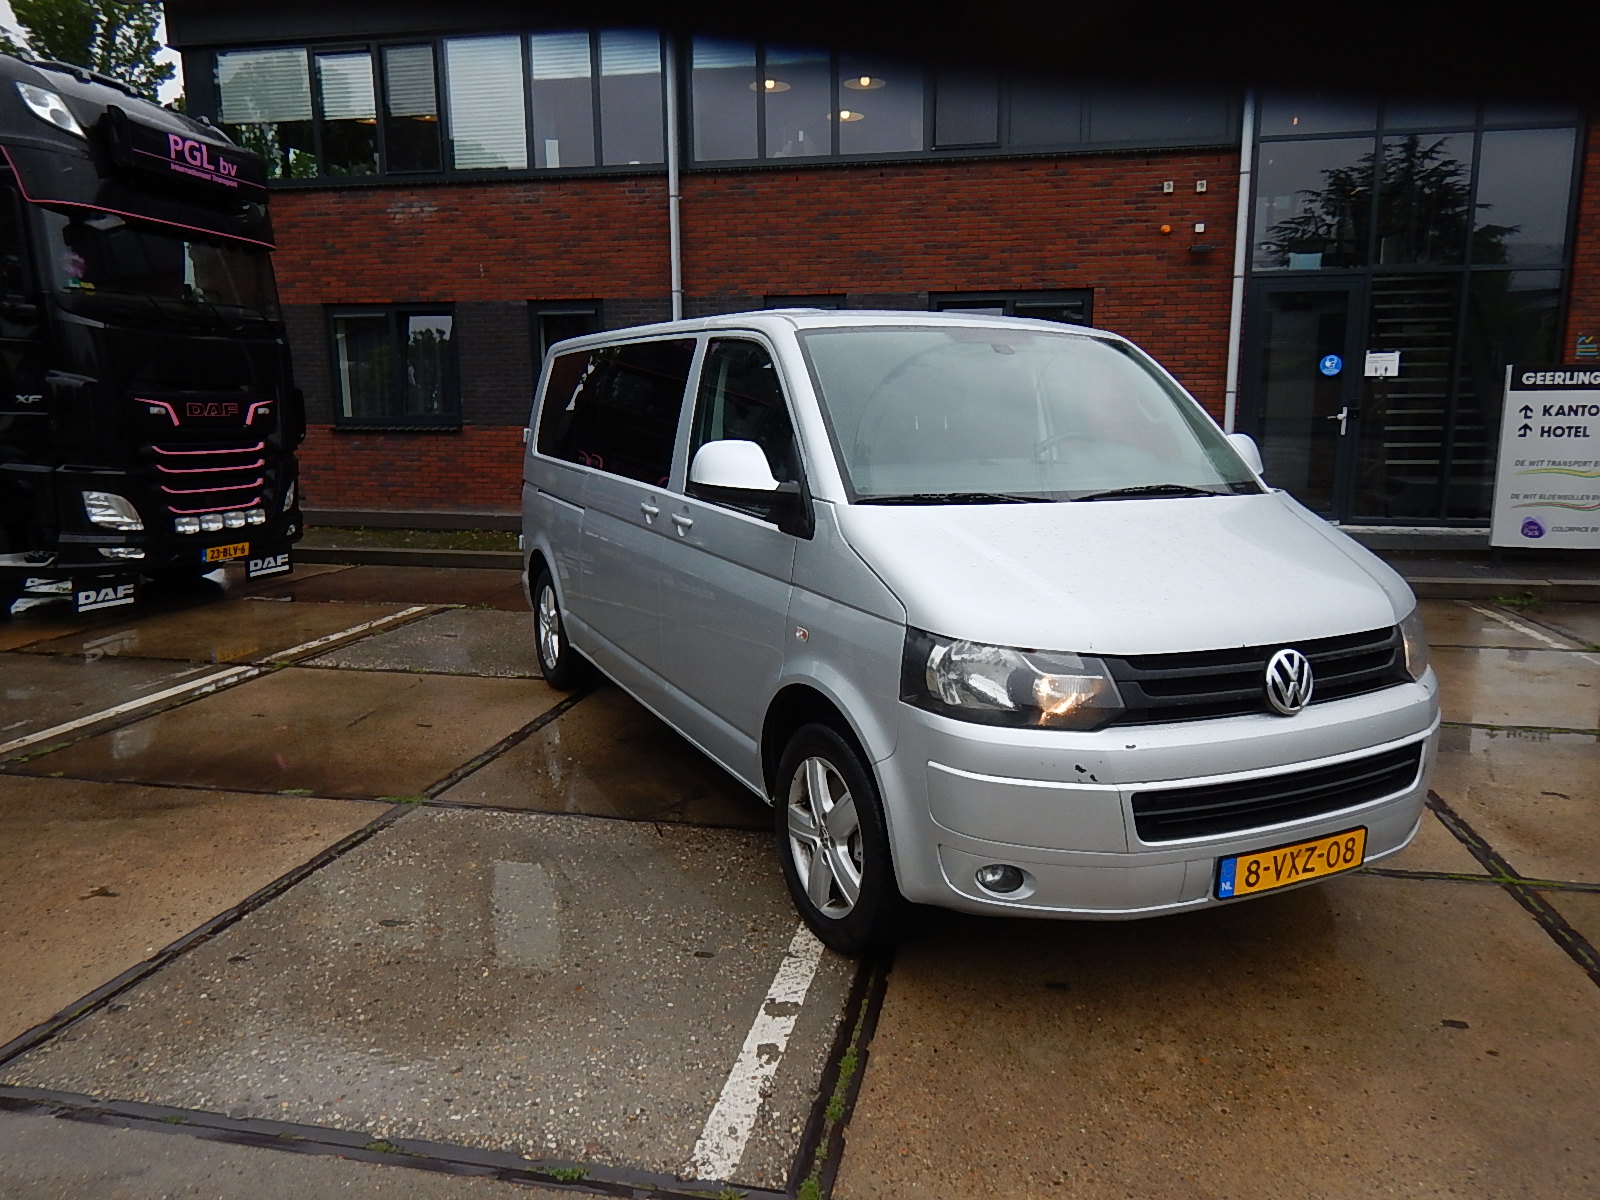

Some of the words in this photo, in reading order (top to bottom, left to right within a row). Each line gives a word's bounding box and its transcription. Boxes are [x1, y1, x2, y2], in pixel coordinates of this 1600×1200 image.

[168, 133, 215, 170] PGL
[219, 156, 237, 177] bv
[15, 394, 43, 404] XF
[186, 402, 240, 417] DAF
[1539, 426, 1590, 438] HOTEL
[1546, 460, 1592, 468] TRANSPORT
[210, 545, 246, 560] 23-BLV-6
[249, 553, 289, 572] DAF
[78, 583, 135, 606] DAF
[1244, 836, 1356, 888] 8-VXZ-08
[1221, 881, 1233, 891] NL
